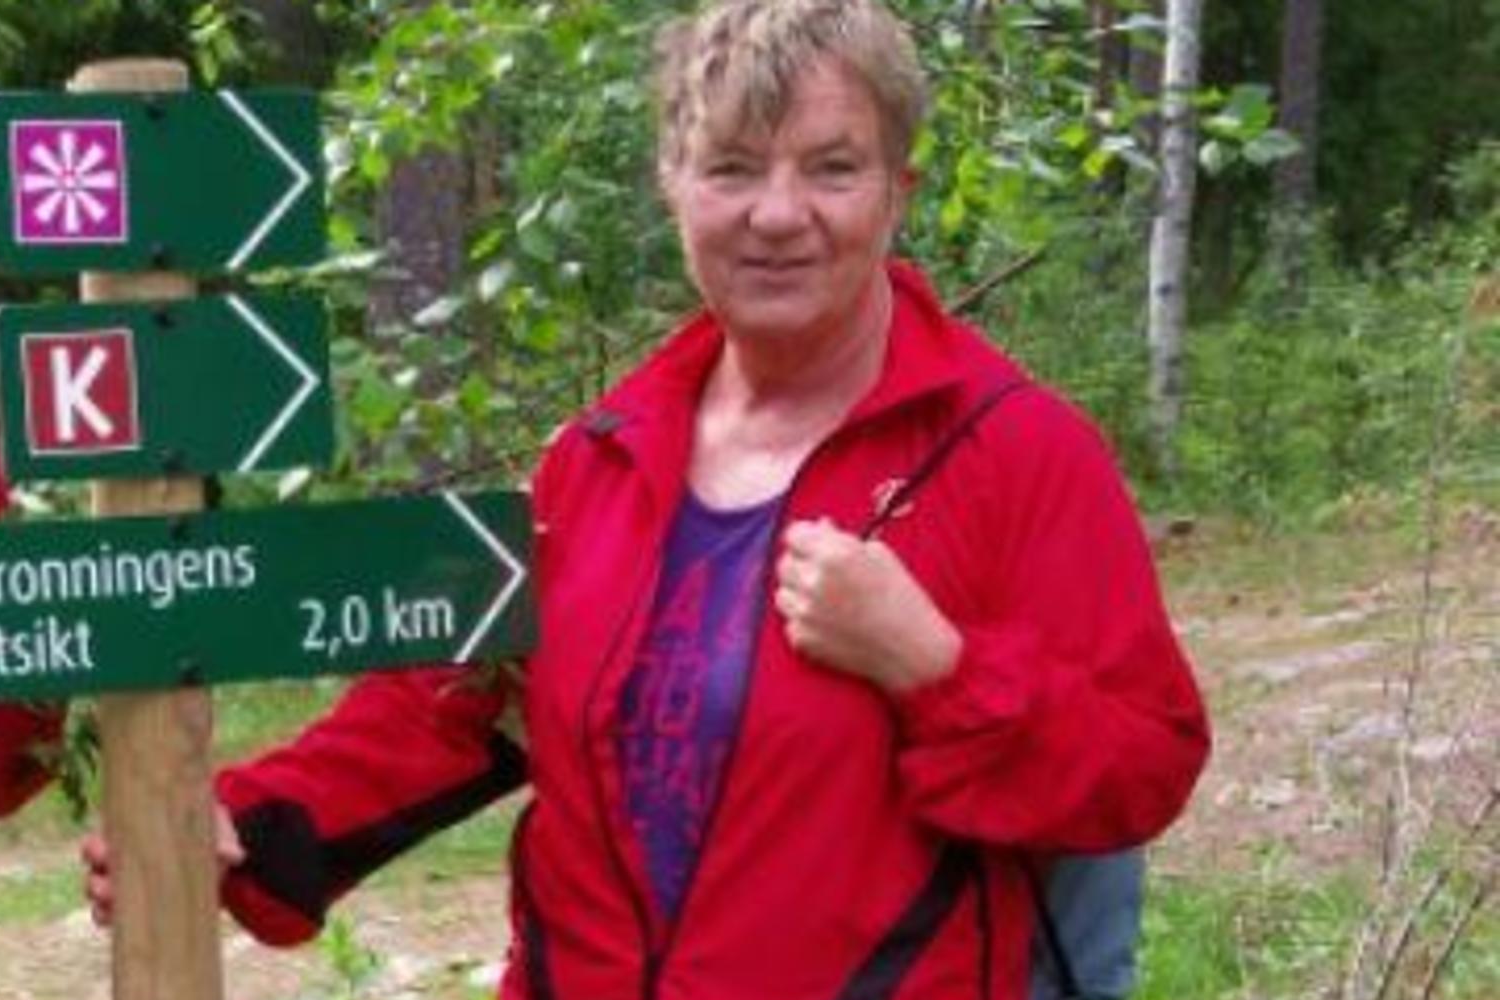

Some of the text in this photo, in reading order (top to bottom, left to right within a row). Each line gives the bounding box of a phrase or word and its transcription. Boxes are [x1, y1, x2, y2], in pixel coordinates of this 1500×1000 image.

[50, 346, 113, 441] K
[299, 586, 455, 658] 2,0 km
